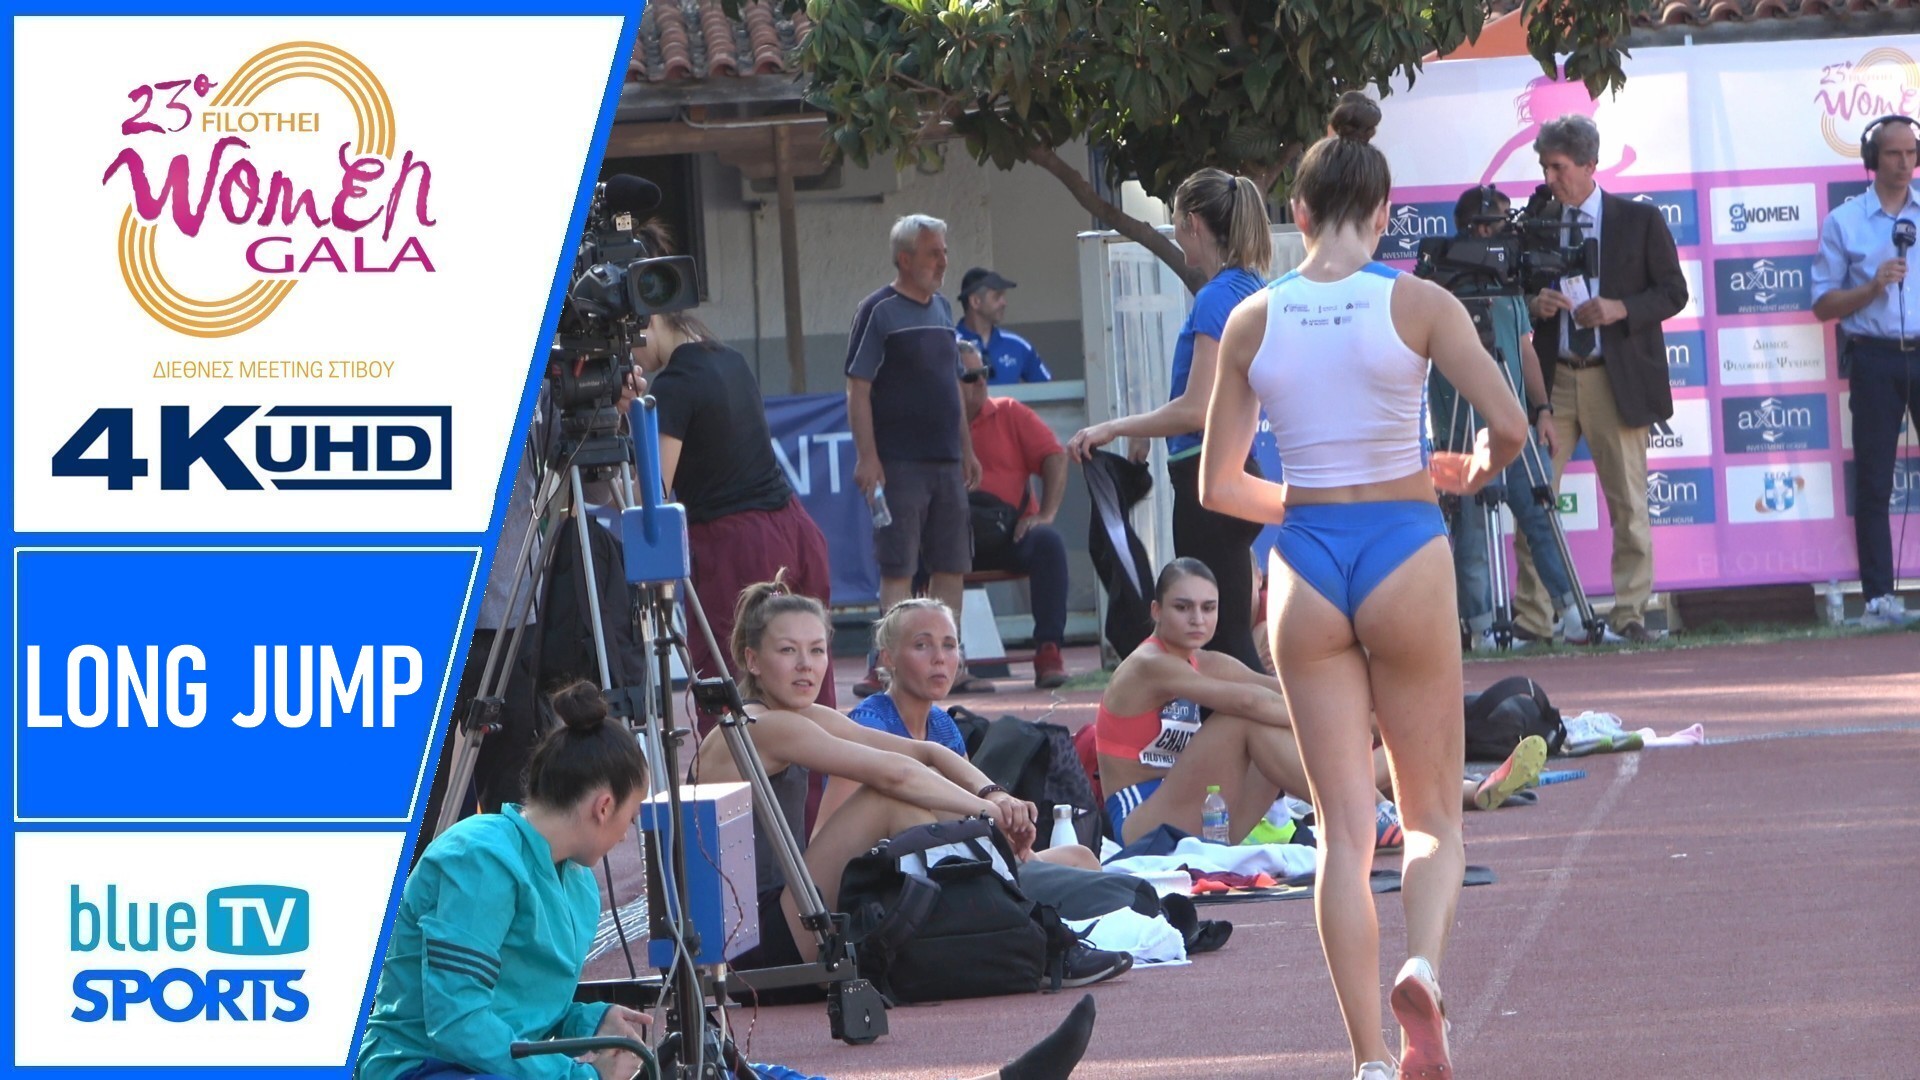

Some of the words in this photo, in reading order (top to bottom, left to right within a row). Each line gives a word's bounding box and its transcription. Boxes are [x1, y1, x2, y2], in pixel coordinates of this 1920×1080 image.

[1382, 251, 1418, 259] INVESTMEN
[1498, 252, 1504, 261] 9
[1730, 269, 1803, 291] axum
[1738, 407, 1811, 429] axum
[1645, 482, 1697, 502] xum
[1562, 496, 1573, 511] 3
